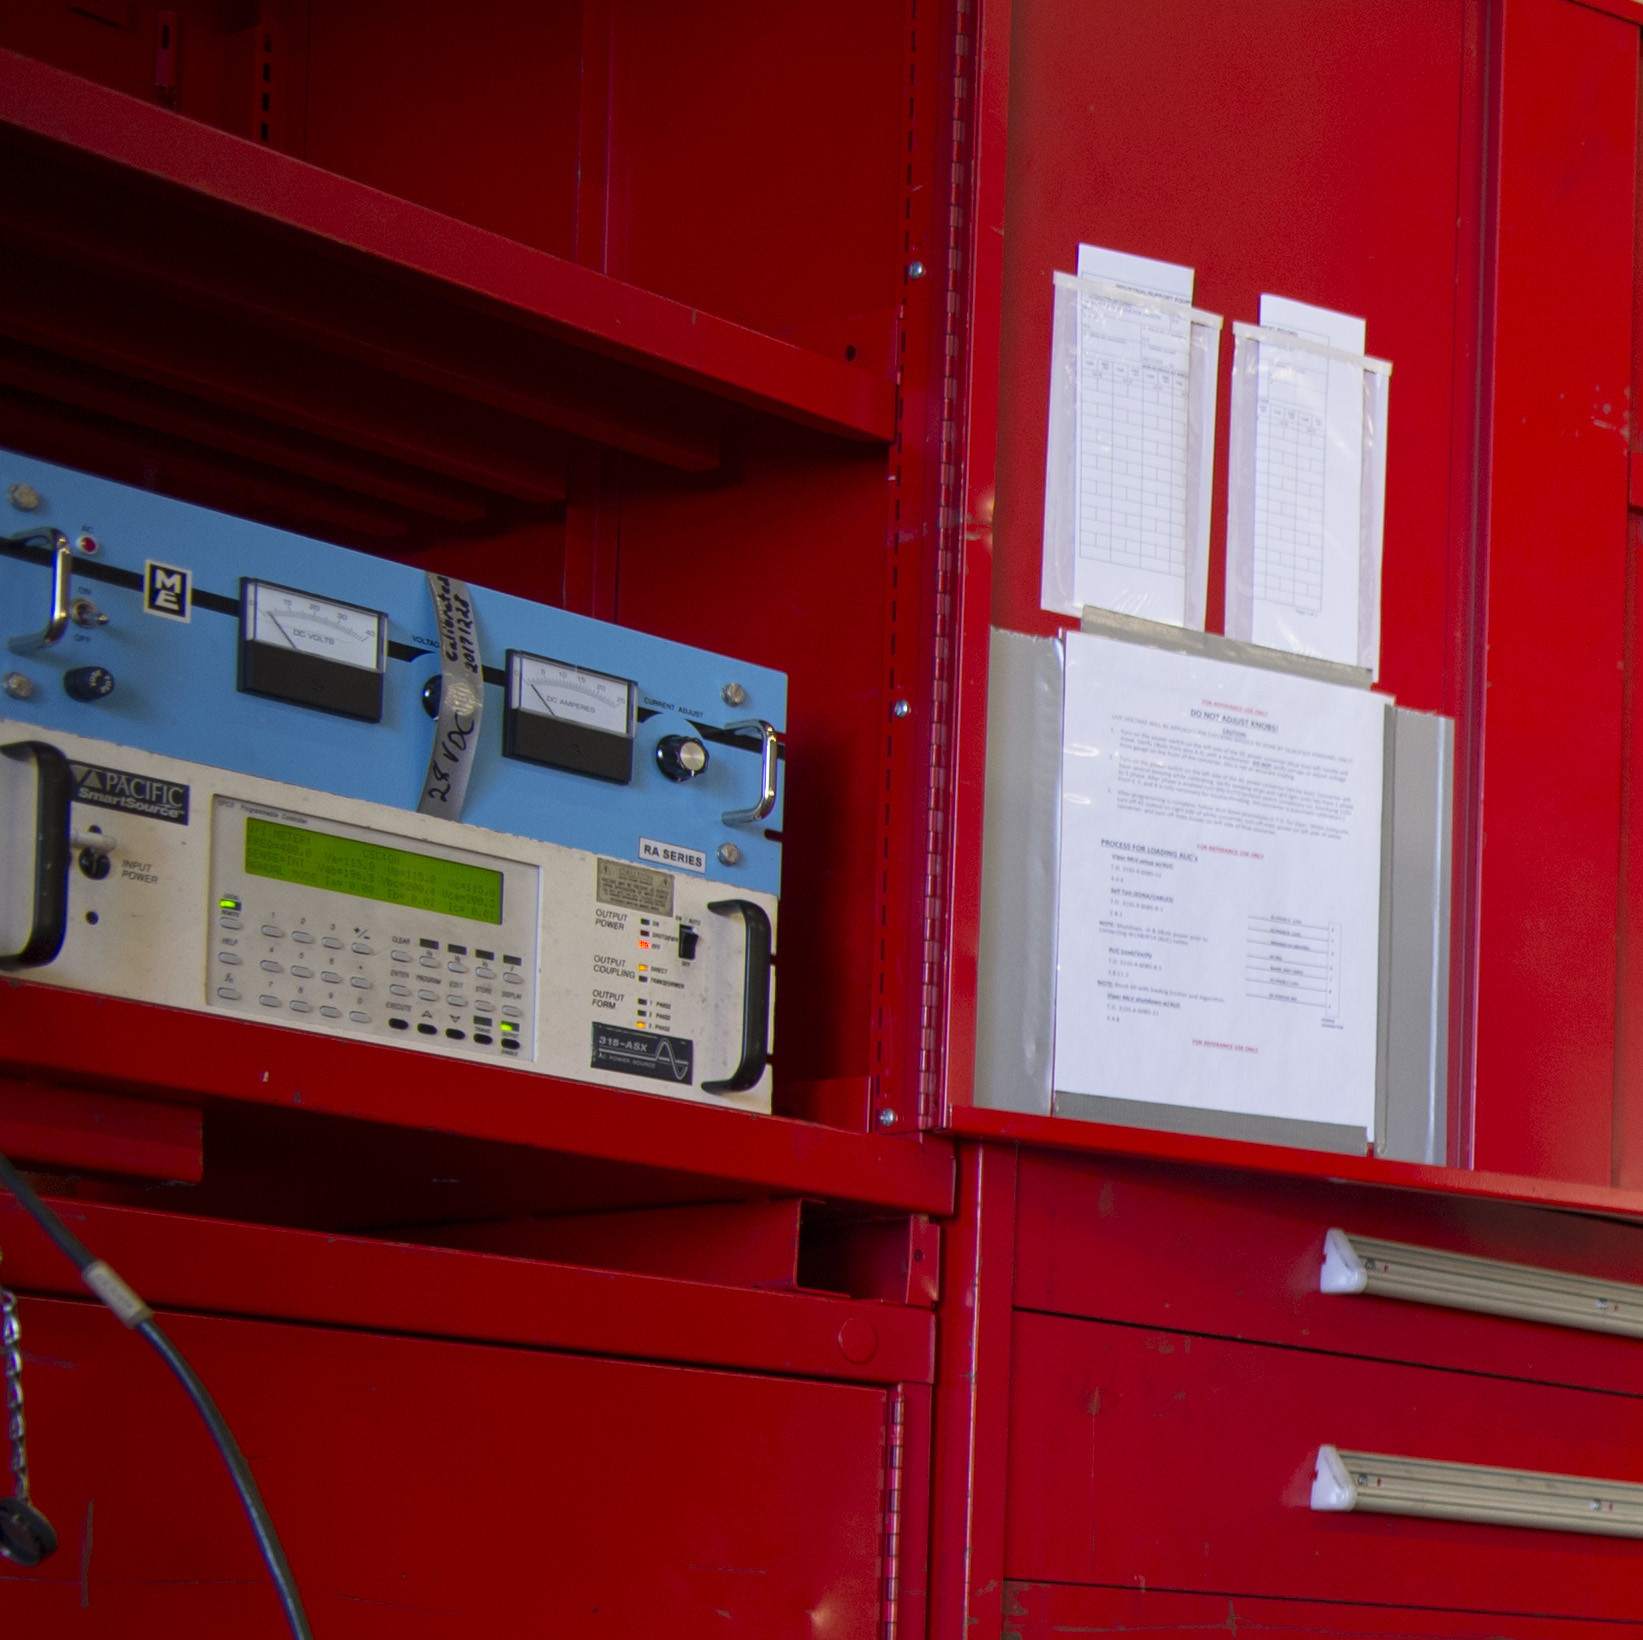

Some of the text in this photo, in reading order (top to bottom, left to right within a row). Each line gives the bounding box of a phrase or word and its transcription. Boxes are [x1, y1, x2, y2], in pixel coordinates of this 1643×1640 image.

[308, 631, 335, 646] VOLTS
[558, 698, 596, 714] AMPERES
[643, 696, 675, 711] CURRENT
[1190, 709, 1202, 718] DO
[1203, 711, 1220, 720] NOT
[1221, 715, 1249, 726] ADJUST
[428, 760, 451, 802] 28
[105, 772, 184, 807] PACIFIC
[643, 844, 702, 867] RA SERIES
[1101, 839, 1131, 850] PROCESS
[1132, 843, 1146, 852] FOR
[1147, 847, 1177, 858] LOADING
[121, 860, 152, 872] INPUT
[121, 870, 158, 884] POWER
[595, 908, 628, 921] OUTPUT
[595, 918, 625, 931] POWER
[593, 954, 626, 967] OUTPUT
[593, 964, 635, 979] COUPLING
[592, 989, 625, 1002] OUTPUT
[592, 998, 616, 1010] FORM
